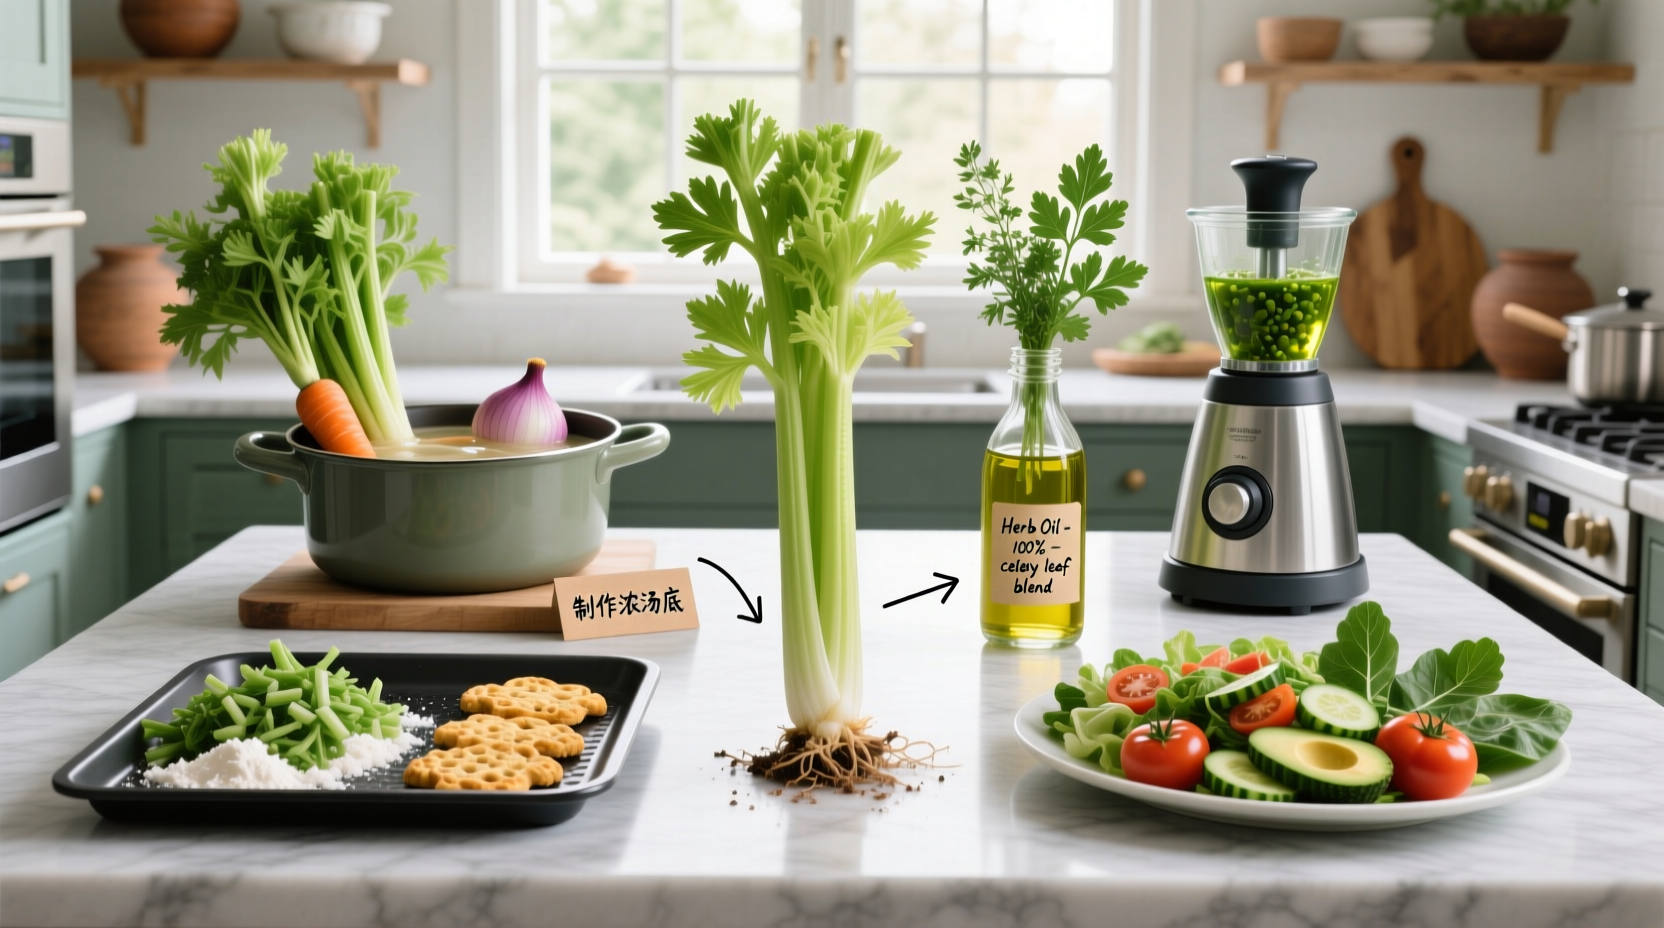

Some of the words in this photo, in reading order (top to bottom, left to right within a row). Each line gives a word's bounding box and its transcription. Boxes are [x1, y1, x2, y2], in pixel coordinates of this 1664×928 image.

[1001, 516, 1037, 535] Herb
[1040, 517, 1061, 535] Oil
[1012, 539, 1046, 555] 100%
[1044, 556, 1072, 577] leaf
[1013, 577, 1053, 594] blend
[572, 586, 684, 622] 制作浓汤底
